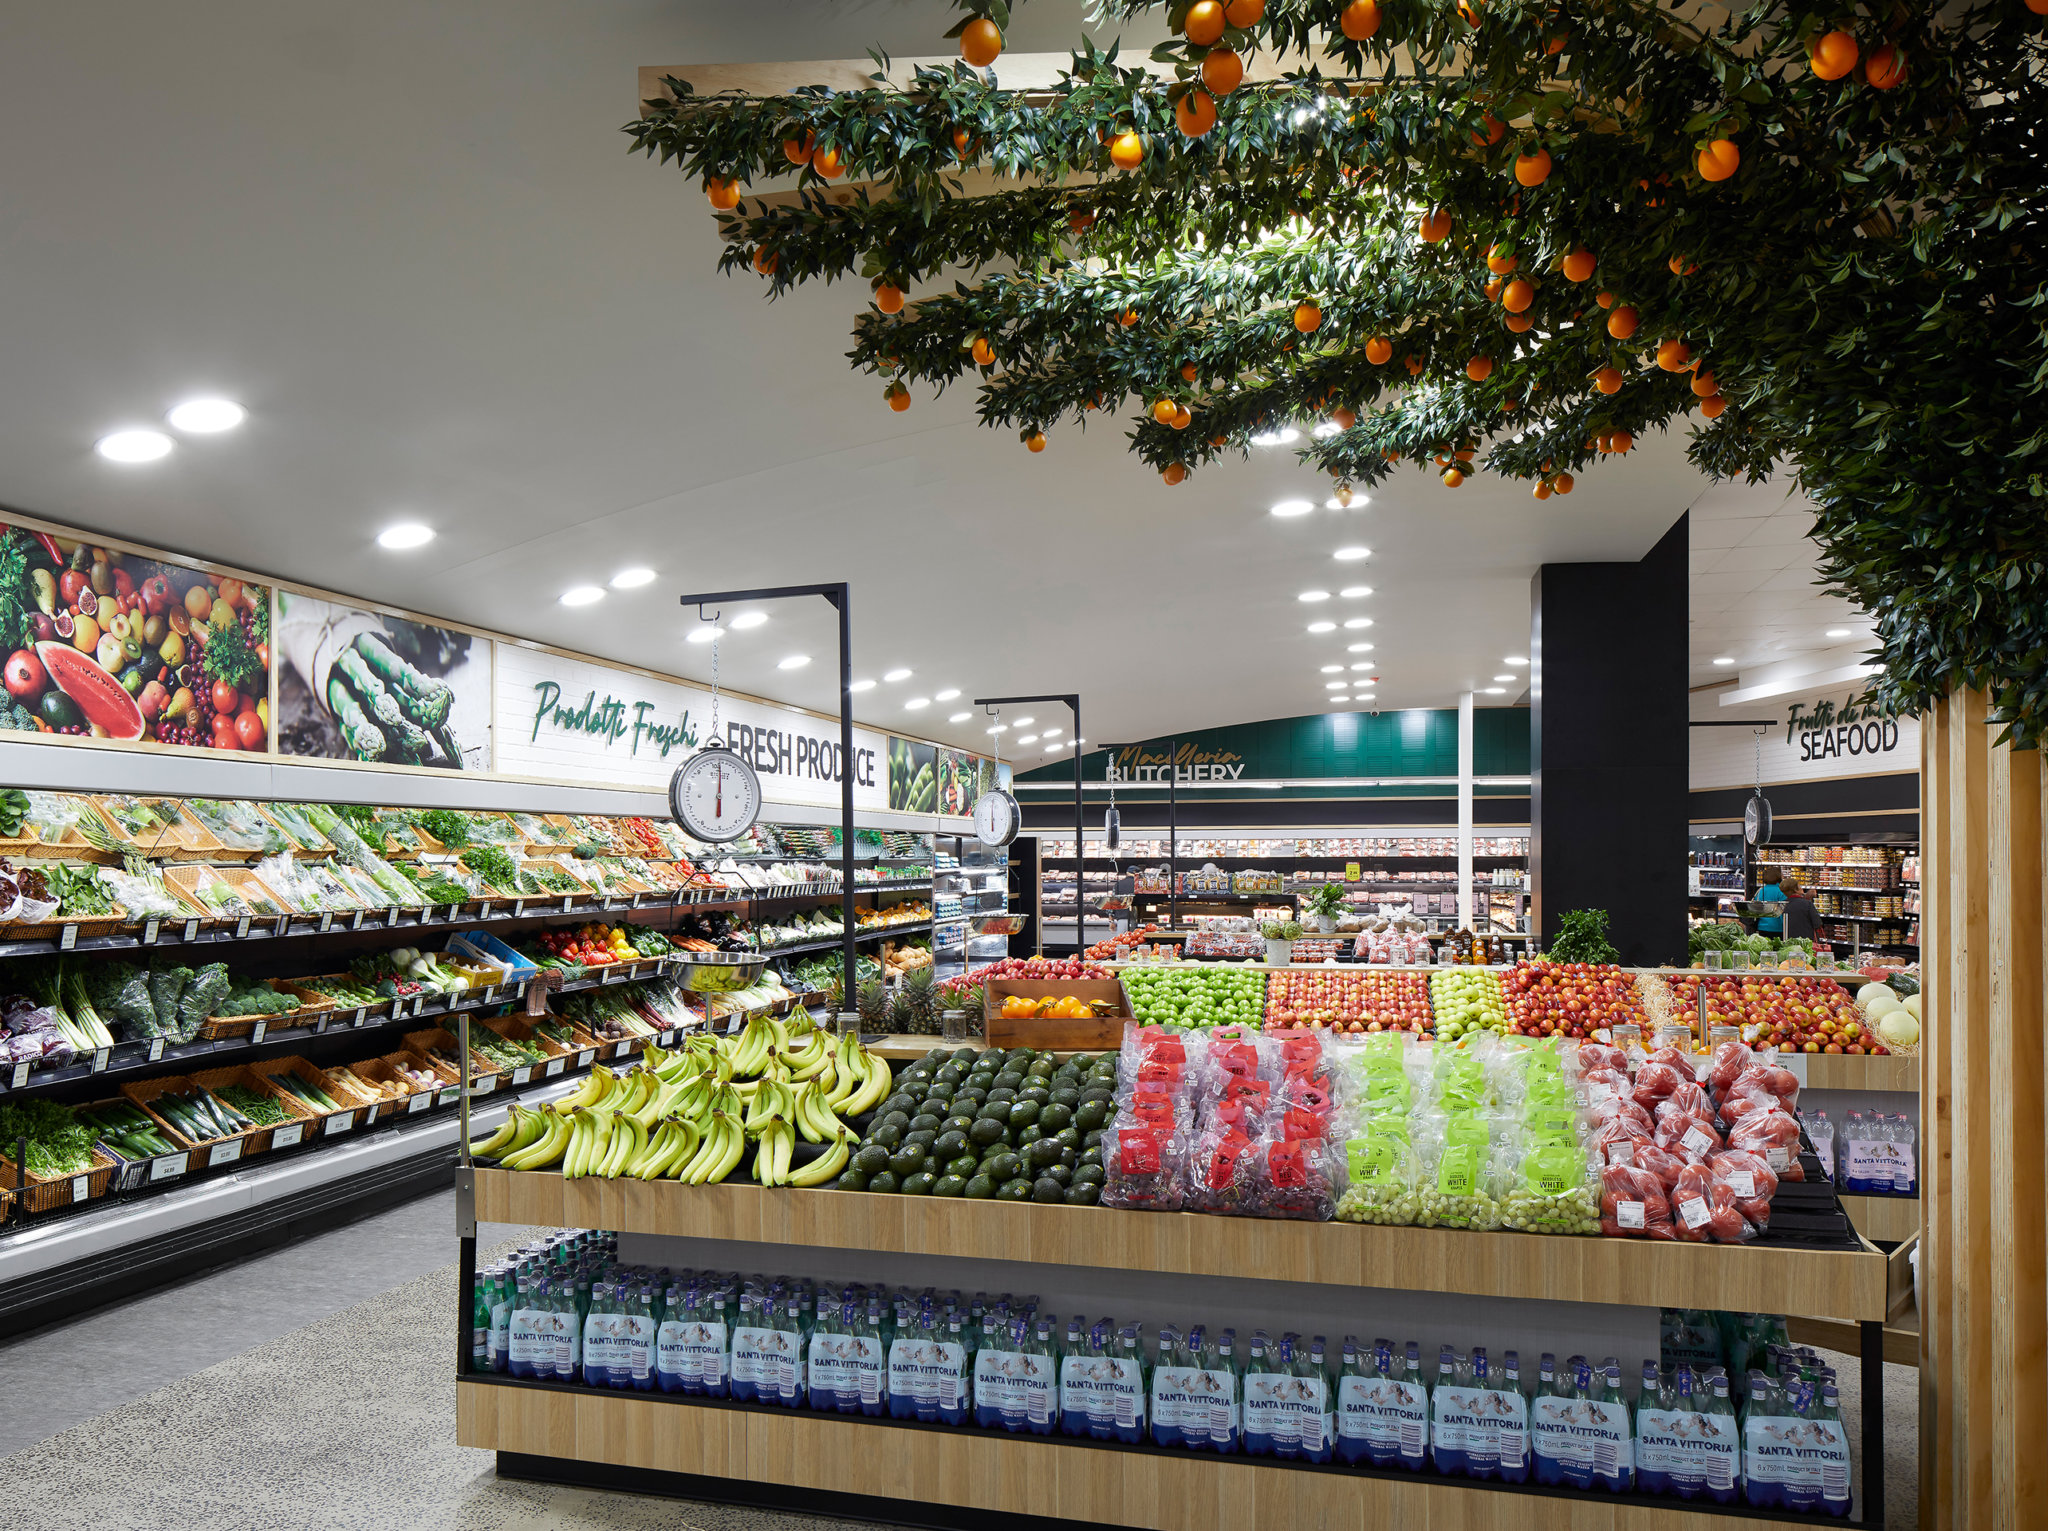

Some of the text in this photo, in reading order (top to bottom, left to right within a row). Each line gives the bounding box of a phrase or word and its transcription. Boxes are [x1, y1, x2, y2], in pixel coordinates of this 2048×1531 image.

[531, 681, 699, 757] Prodotti Freschi
[1800, 720, 1899, 762] SEAFOOD
[727, 721, 792, 776] FRESH
[1105, 763, 1245, 781] BUTCHERY
[1875, 1158, 1907, 1167] VITTORIA
[1447, 1178, 1468, 1186] WHITE
[1539, 1181, 1565, 1189] WHITE
[513, 1332, 573, 1344] SANTA VITTORIA
[589, 1337, 649, 1348] SANTA VITTORIA
[660, 1344, 720, 1354] SANTA VITTORIA
[736, 1351, 795, 1365] SANTA VITTORIA
[814, 1358, 879, 1371] SANTA VITTORIA
[892, 1363, 958, 1376] SANTA VITTORIA
[979, 1374, 1048, 1389] SANTA VITTORIA
[1066, 1380, 1135, 1393] SANTA VITTORIA
[1158, 1392, 1231, 1407] SANTA VITTORIA
[1249, 1400, 1279, 1409] SANTA
[1346, 1403, 1424, 1420] SANTA VITTORIA
[1443, 1414, 1524, 1430] SANTA VITTORIA
[1535, 1421, 1620, 1441] SANTA VITTORIA
[1642, 1435, 1733, 1453] SANTA VITTORIA
[1757, 1445, 1845, 1460] SANTA VITTORI
